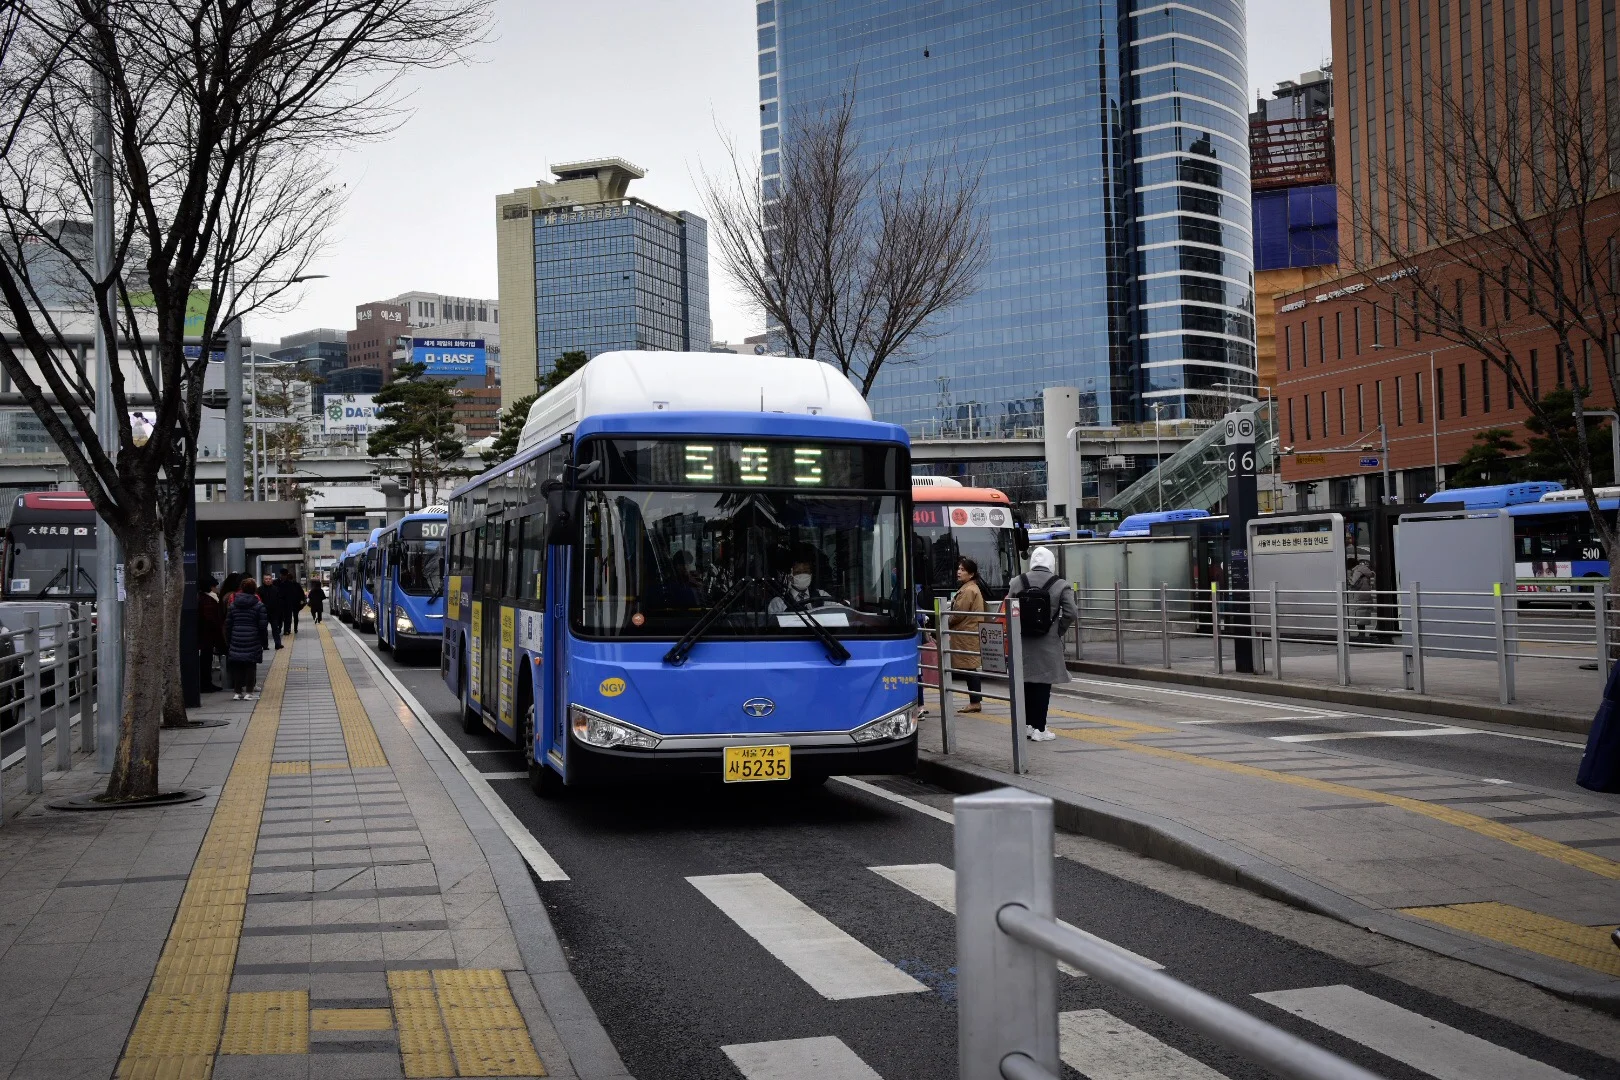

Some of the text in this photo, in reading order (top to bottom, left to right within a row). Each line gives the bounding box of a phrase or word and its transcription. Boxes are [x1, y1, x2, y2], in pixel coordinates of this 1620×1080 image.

[561, 206, 629, 224] 한국주택금융공사
[380, 310, 402, 322] 에스원
[486, 345, 500, 354] HSB
[443, 353, 474, 364] BASF
[1228, 452, 1236, 471] 6
[1241, 451, 1254, 471] 6
[913, 510, 937, 524] 401
[28, 526, 69, 535] 大韓民國
[421, 523, 448, 537] 507
[1258, 536, 1329, 548] 서울역 버스 환승 센터 종합 안내도
[1582, 547, 1600, 559] 500
[601, 683, 625, 693] NGV
[741, 749, 774, 758] 서울 74
